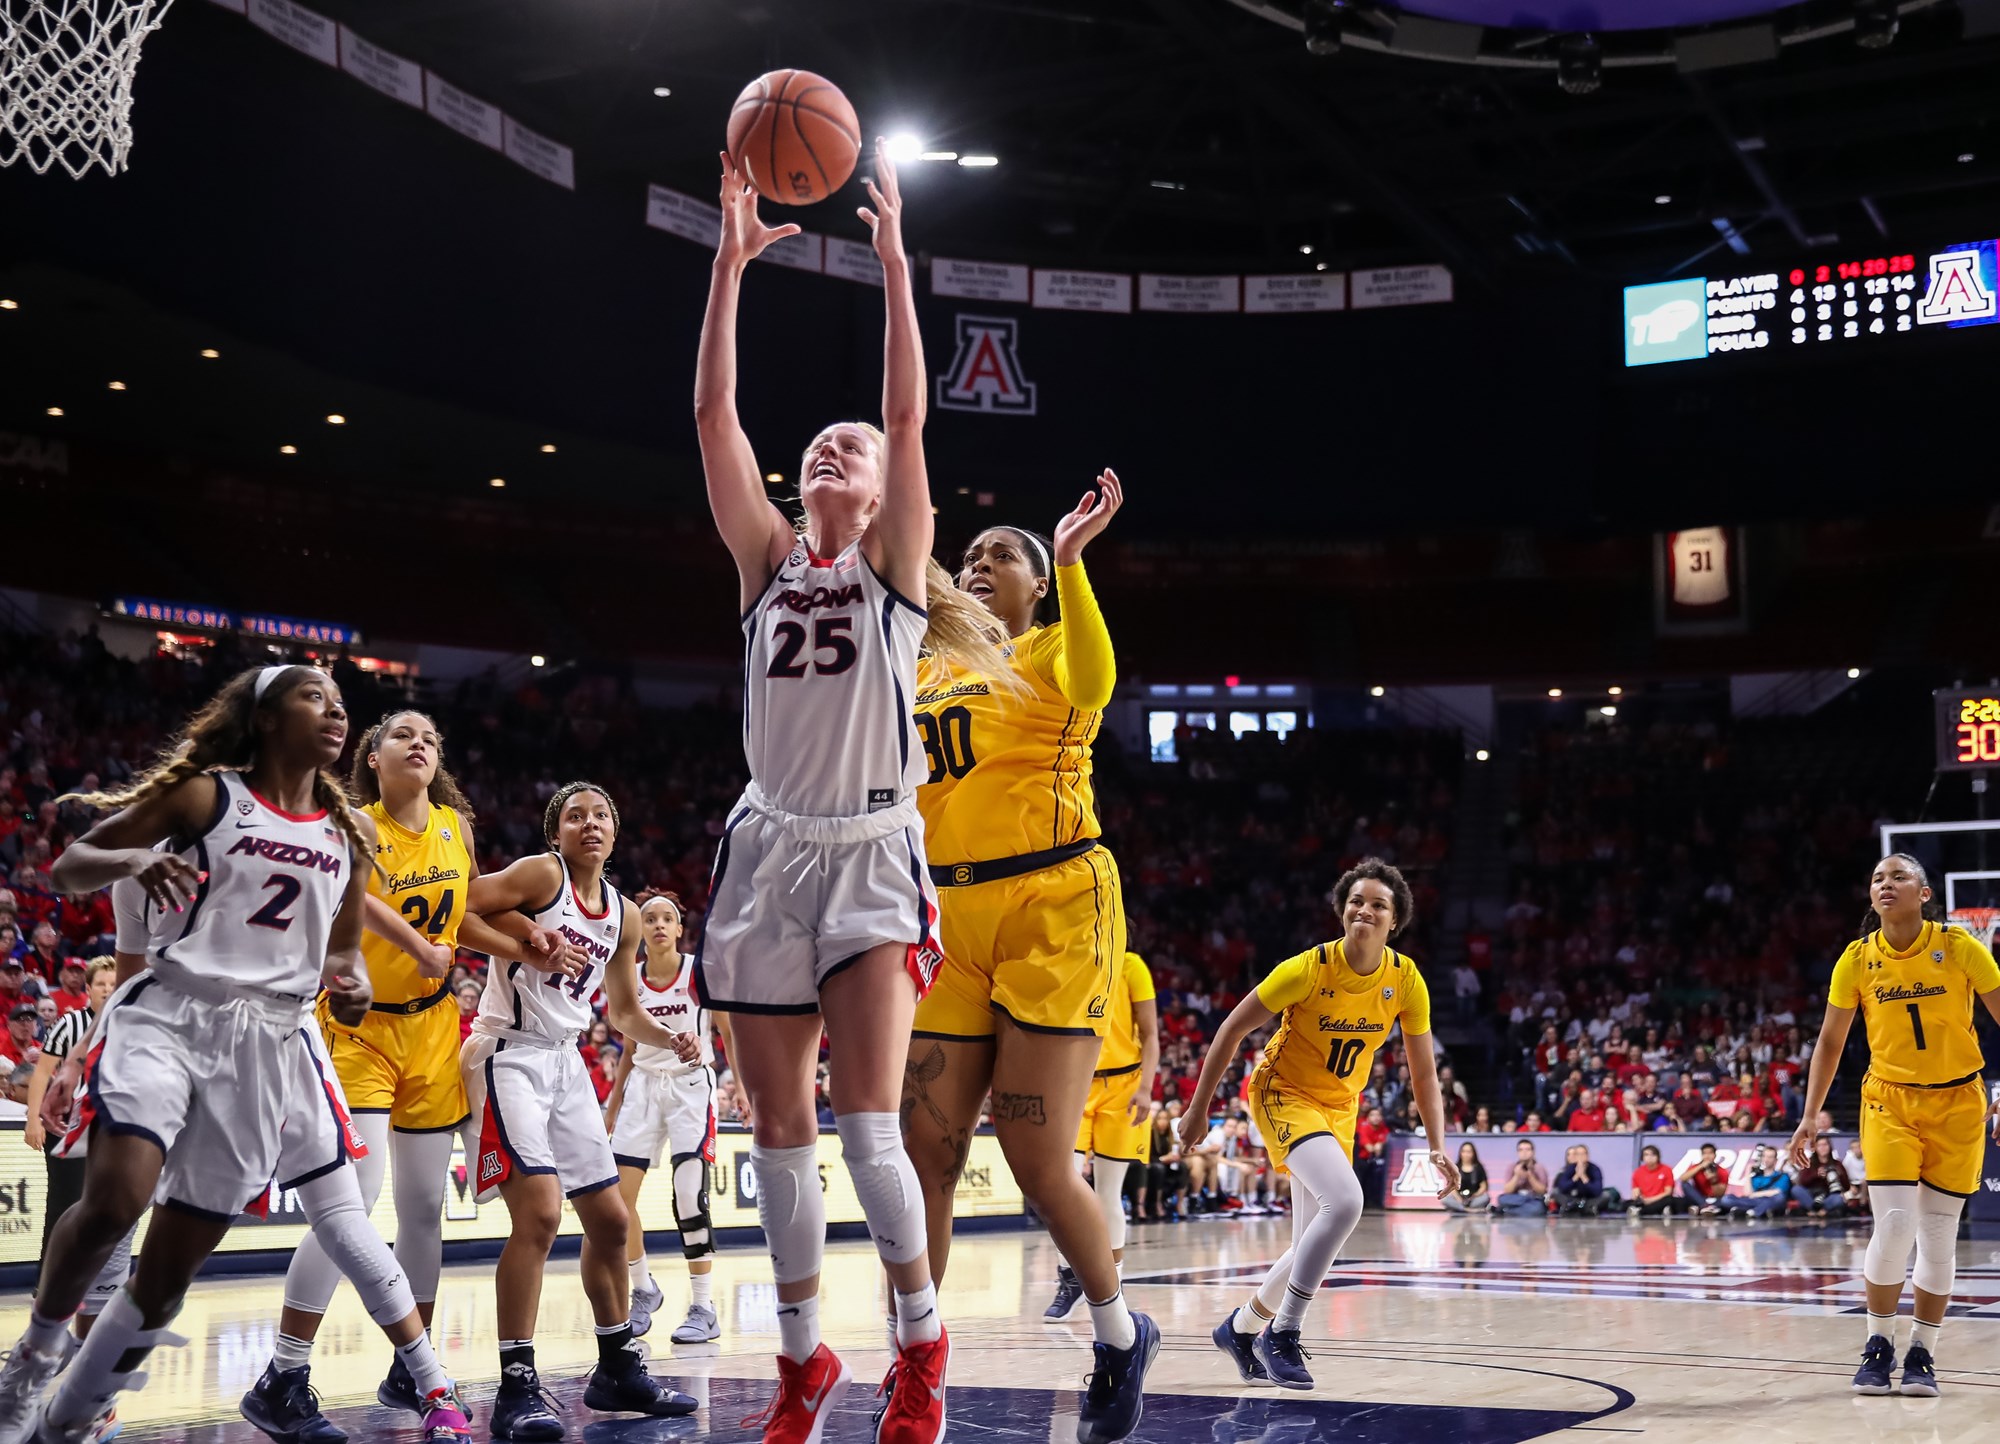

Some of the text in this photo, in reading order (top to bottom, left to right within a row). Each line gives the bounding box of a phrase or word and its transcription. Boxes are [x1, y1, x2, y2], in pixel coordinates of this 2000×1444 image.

[1706, 274, 1778, 297] PLAYER
[1838, 261, 1861, 279] 14
[1706, 292, 1776, 316] POINTS
[1790, 288, 1805, 304] 4
[1843, 281, 1855, 298] 1
[1864, 277, 1889, 295] 12
[1891, 274, 1916, 292] 14
[1916, 249, 1996, 325] A
[1868, 297, 1884, 314] 4
[1707, 314, 1911, 353] FOULS 3 2 2 4 2
[936, 313, 1036, 415] A
[1689, 550, 1713, 573] 31
[135, 602, 343, 643] ARIZONA WILDCATS
[766, 617, 857, 678] 25
[1957, 723, 2000, 762] 30
[874, 792, 888, 800] 44
[226, 835, 341, 880] ARIZONA
[388, 865, 459, 894] Golden Bears
[246, 873, 302, 931] 2
[401, 889, 454, 934] 24
[557, 923, 610, 962] ARIZONA
[1087, 995, 1107, 1018] Cal
[1875, 981, 1947, 1004] Golden Bears
[1318, 1014, 1384, 1031] Golden Bears
[1906, 1003, 1926, 1050] 1
[1326, 1038, 1366, 1079] 10
[1277, 1123, 1291, 1144] Cal
[481, 1150, 502, 1181] A
[1391, 1148, 1446, 1196] A
